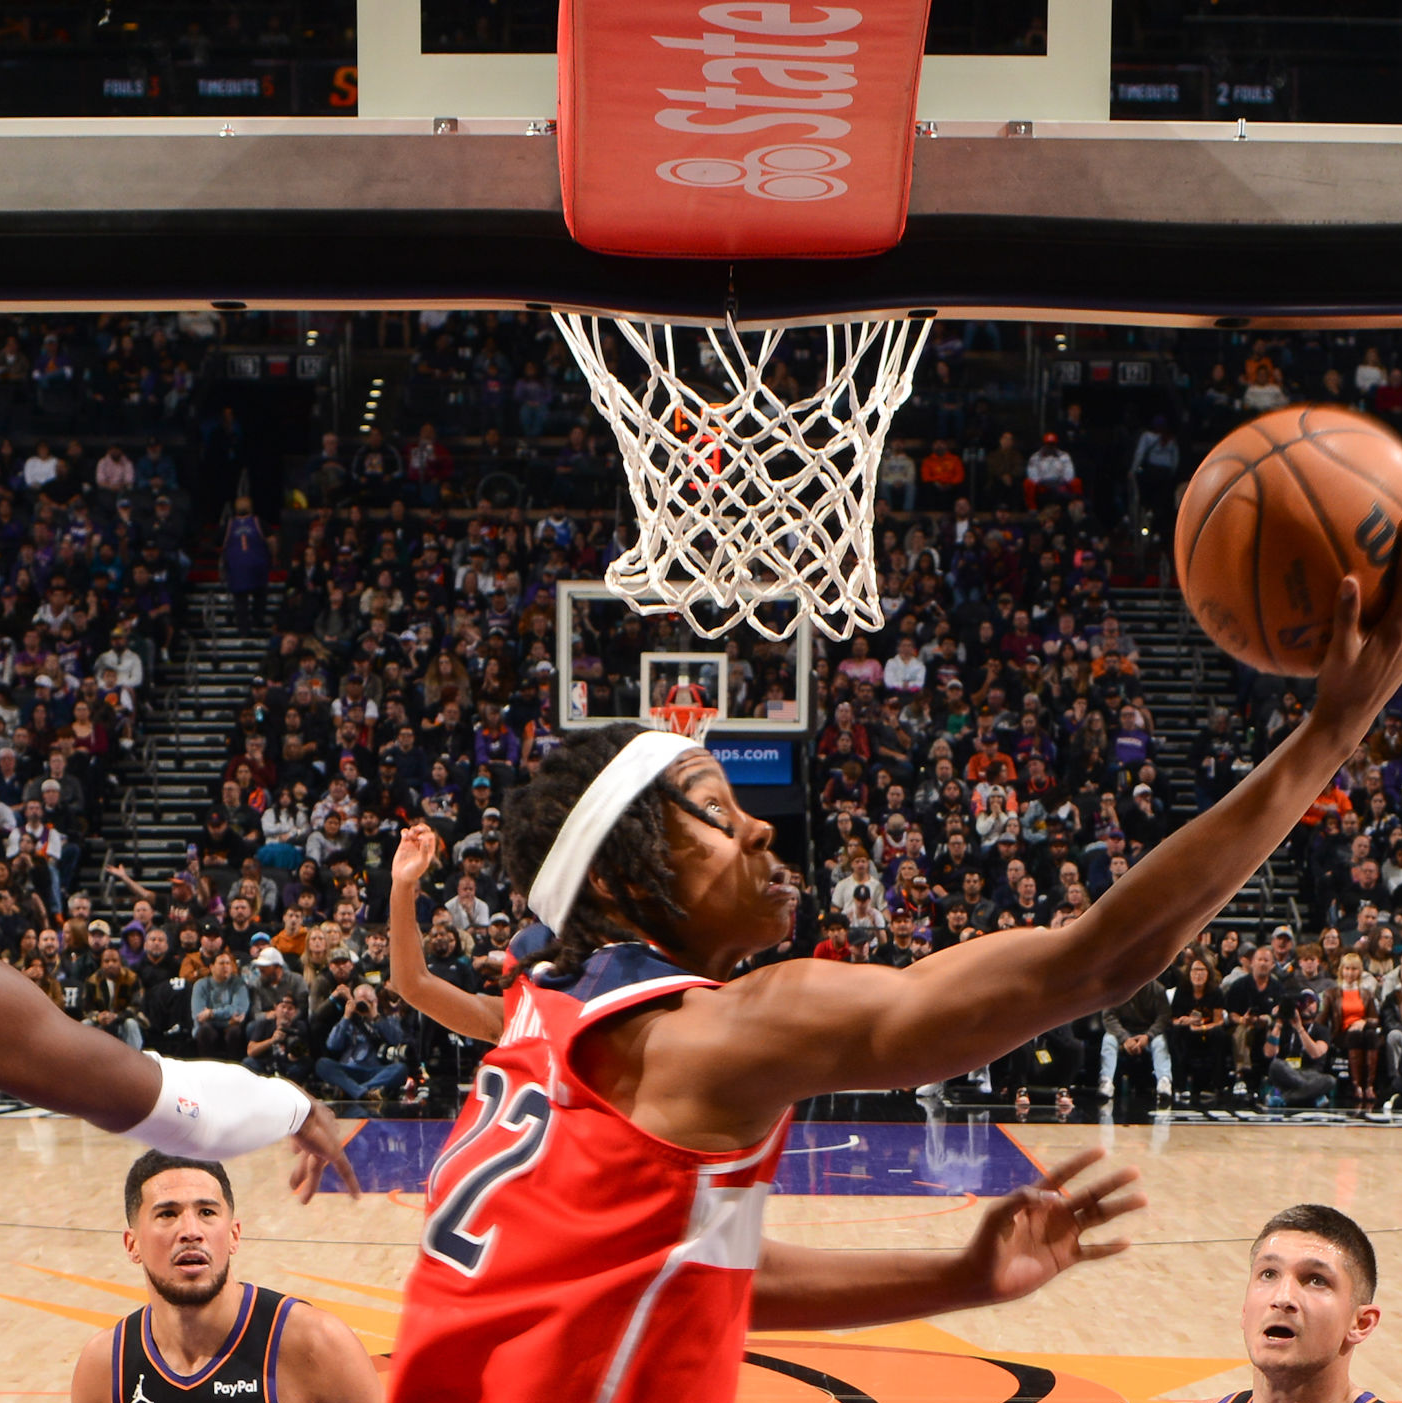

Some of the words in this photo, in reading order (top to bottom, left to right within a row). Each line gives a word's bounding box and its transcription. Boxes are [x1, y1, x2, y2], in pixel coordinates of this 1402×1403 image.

[650, 2, 863, 139] State
[103, 78, 145, 98] FOULS
[197, 77, 261, 98] TIMEOUTS
[1117, 83, 1181, 101] TIMEOUTS
[1216, 82, 1231, 106] 2
[1232, 84, 1276, 104] FOULS
[421, 1063, 554, 1279] 22
[213, 1379, 258, 1398] PayPal
